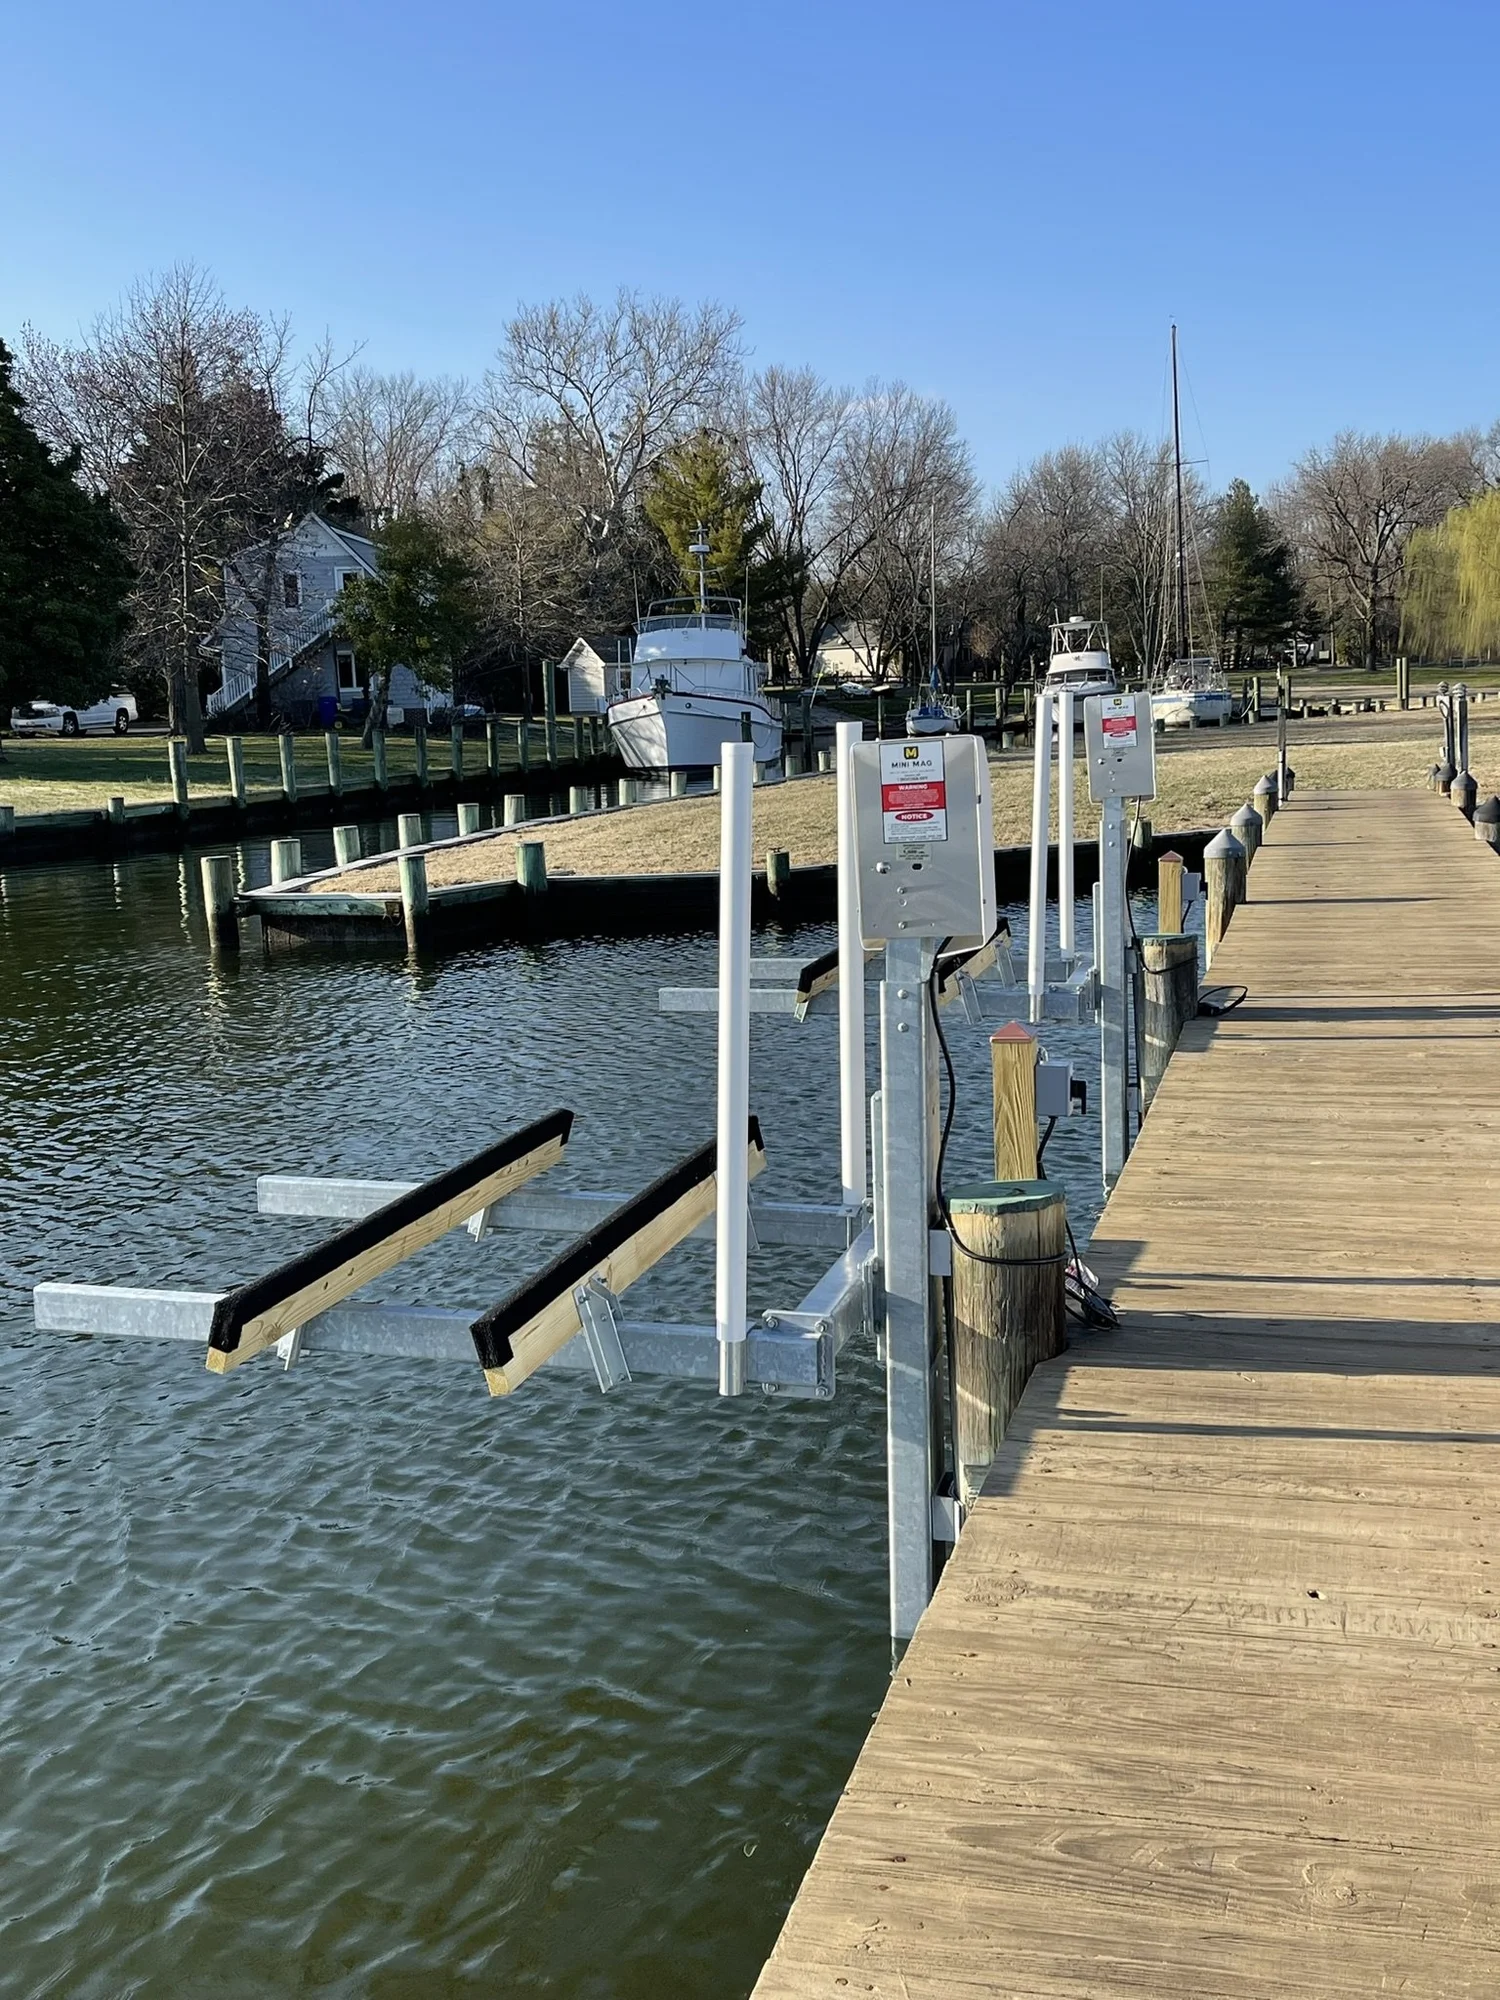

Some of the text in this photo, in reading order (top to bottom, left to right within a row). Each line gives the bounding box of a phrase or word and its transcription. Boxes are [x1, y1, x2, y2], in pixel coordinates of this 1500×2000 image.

[891, 760, 932, 769] MINI MAG
[898, 783, 928, 791] WARNING
